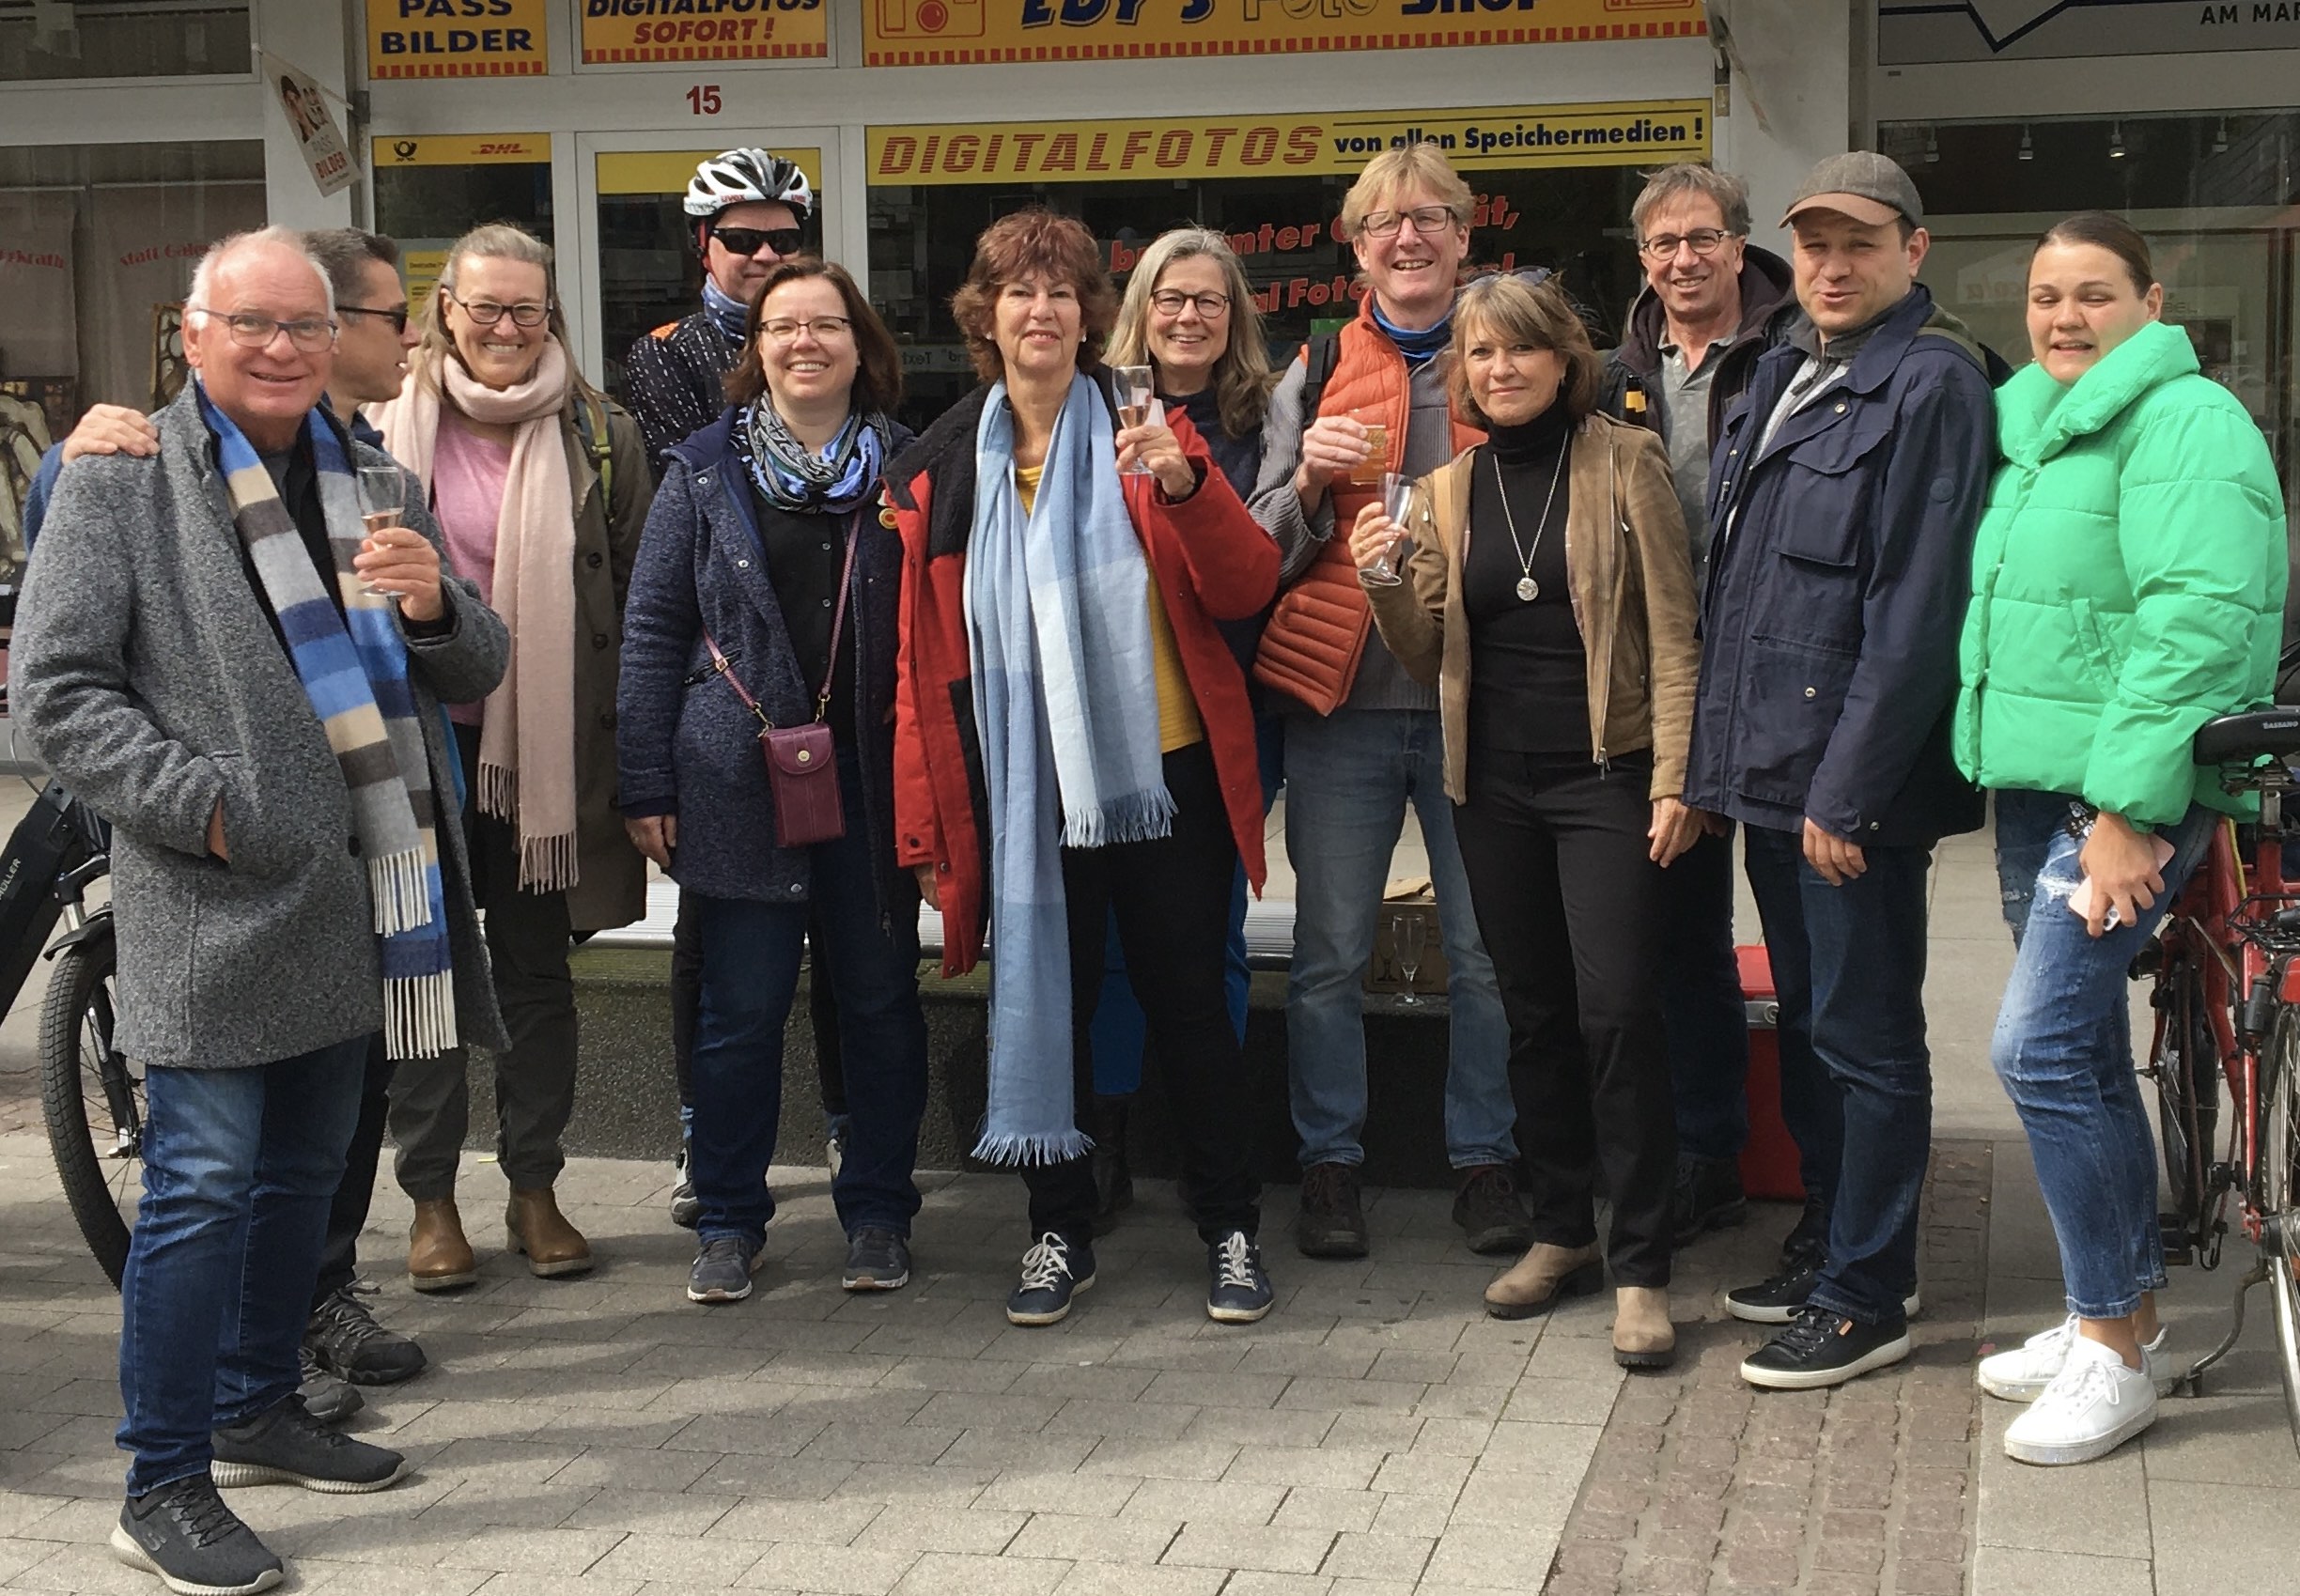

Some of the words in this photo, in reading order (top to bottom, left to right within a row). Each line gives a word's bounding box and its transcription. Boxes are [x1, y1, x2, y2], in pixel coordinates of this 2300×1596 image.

[399, 0, 512, 18] PASS
[2200, 5, 2238, 24] AM
[381, 29, 534, 54] BILDER
[633, 18, 757, 44] SOFORT
[686, 85, 722, 115] 15
[480, 143, 522, 155] DHL
[878, 125, 1323, 175] DIGITALFOTOS
[1333, 135, 1381, 153] von
[1465, 120, 1686, 153] Speichermedien
[315, 151, 348, 178] BILDER
